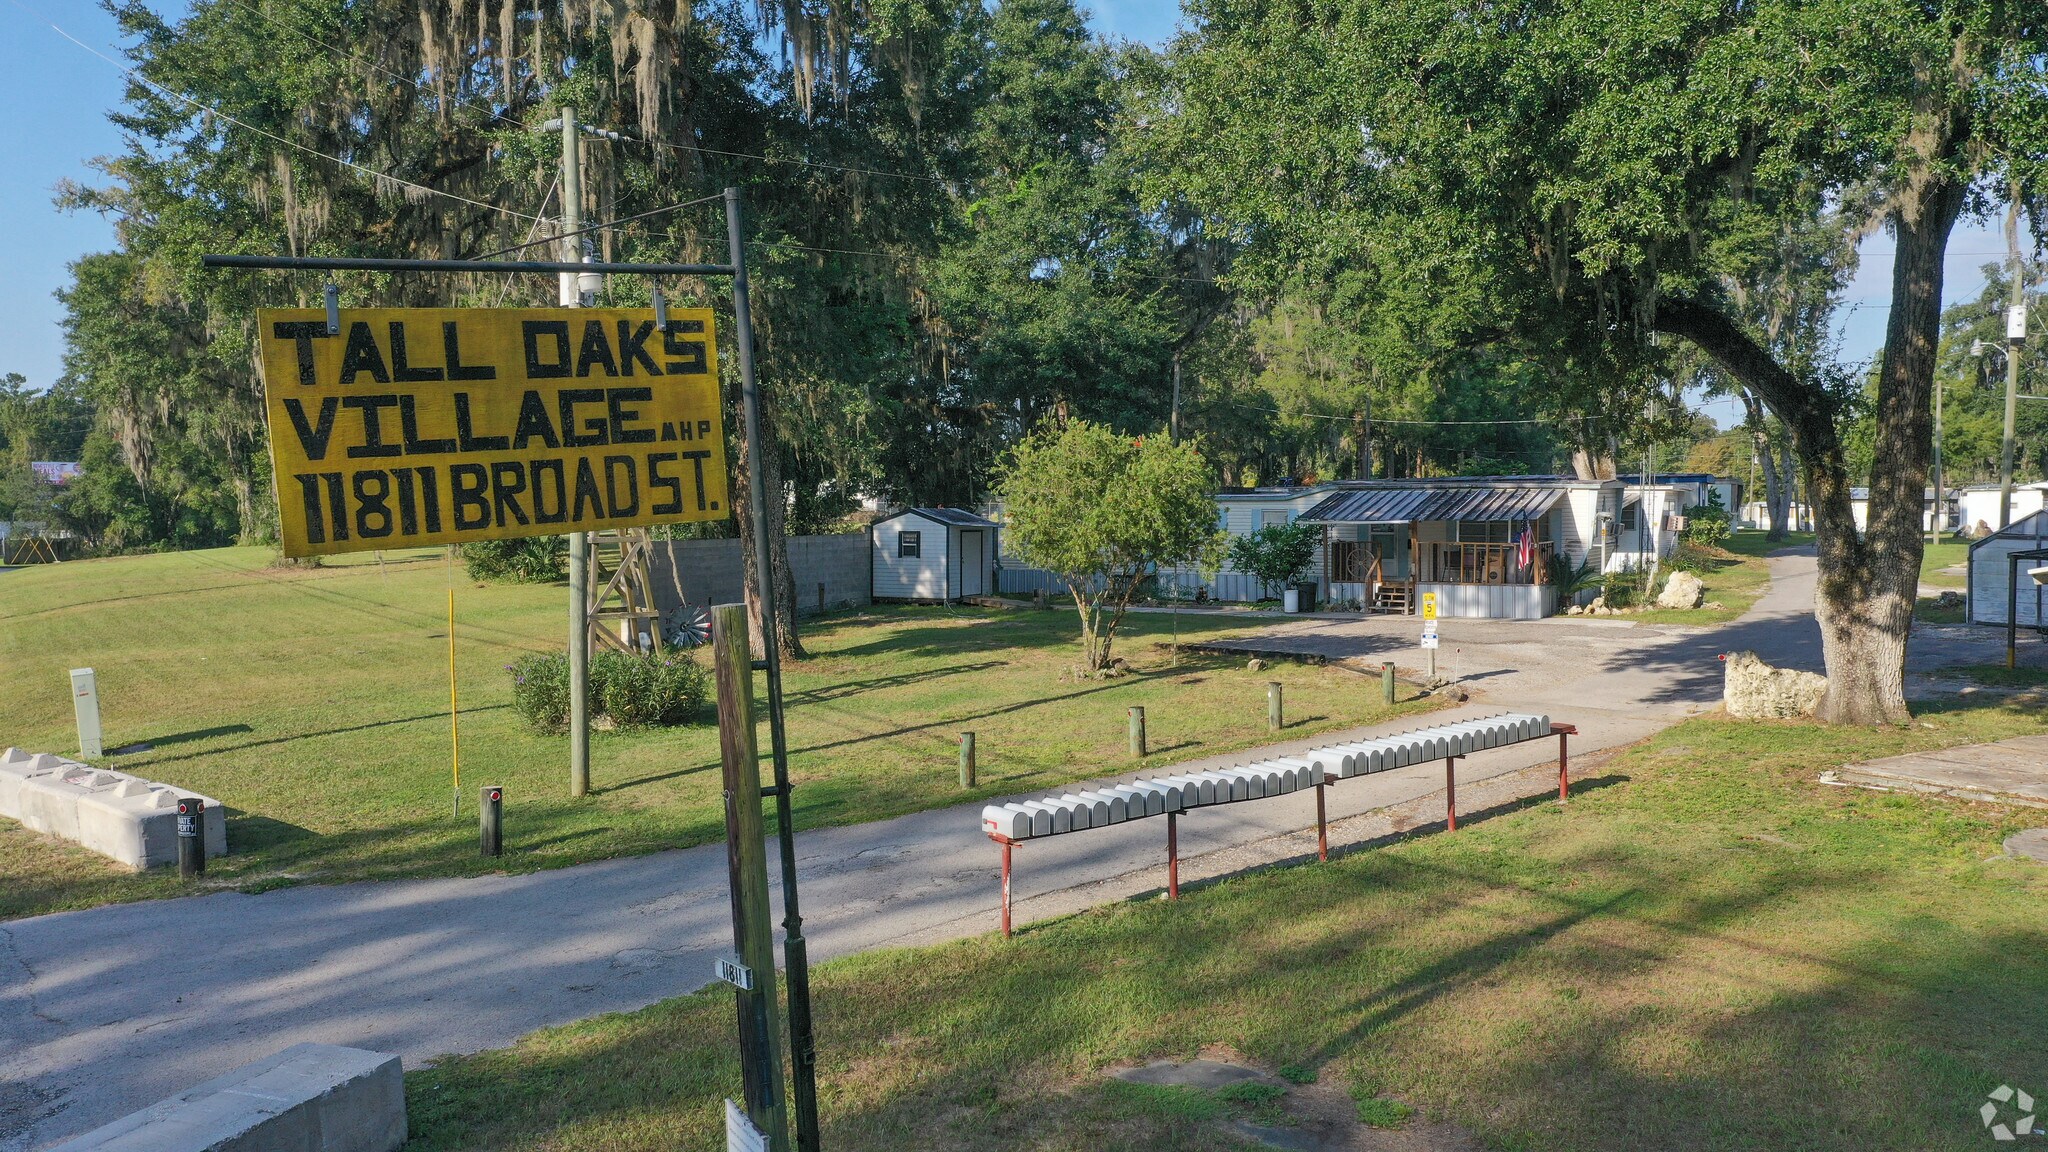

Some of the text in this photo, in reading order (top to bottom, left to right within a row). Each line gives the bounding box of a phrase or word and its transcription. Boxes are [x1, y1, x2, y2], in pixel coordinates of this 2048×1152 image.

[274, 320, 708, 385] TALL OAKS
[283, 387, 657, 460] VILLAGE
[294, 450, 720, 544] 11811 BROAD ST.
[1426, 603, 1432, 613] 5
[722, 960, 743, 987] 11811
